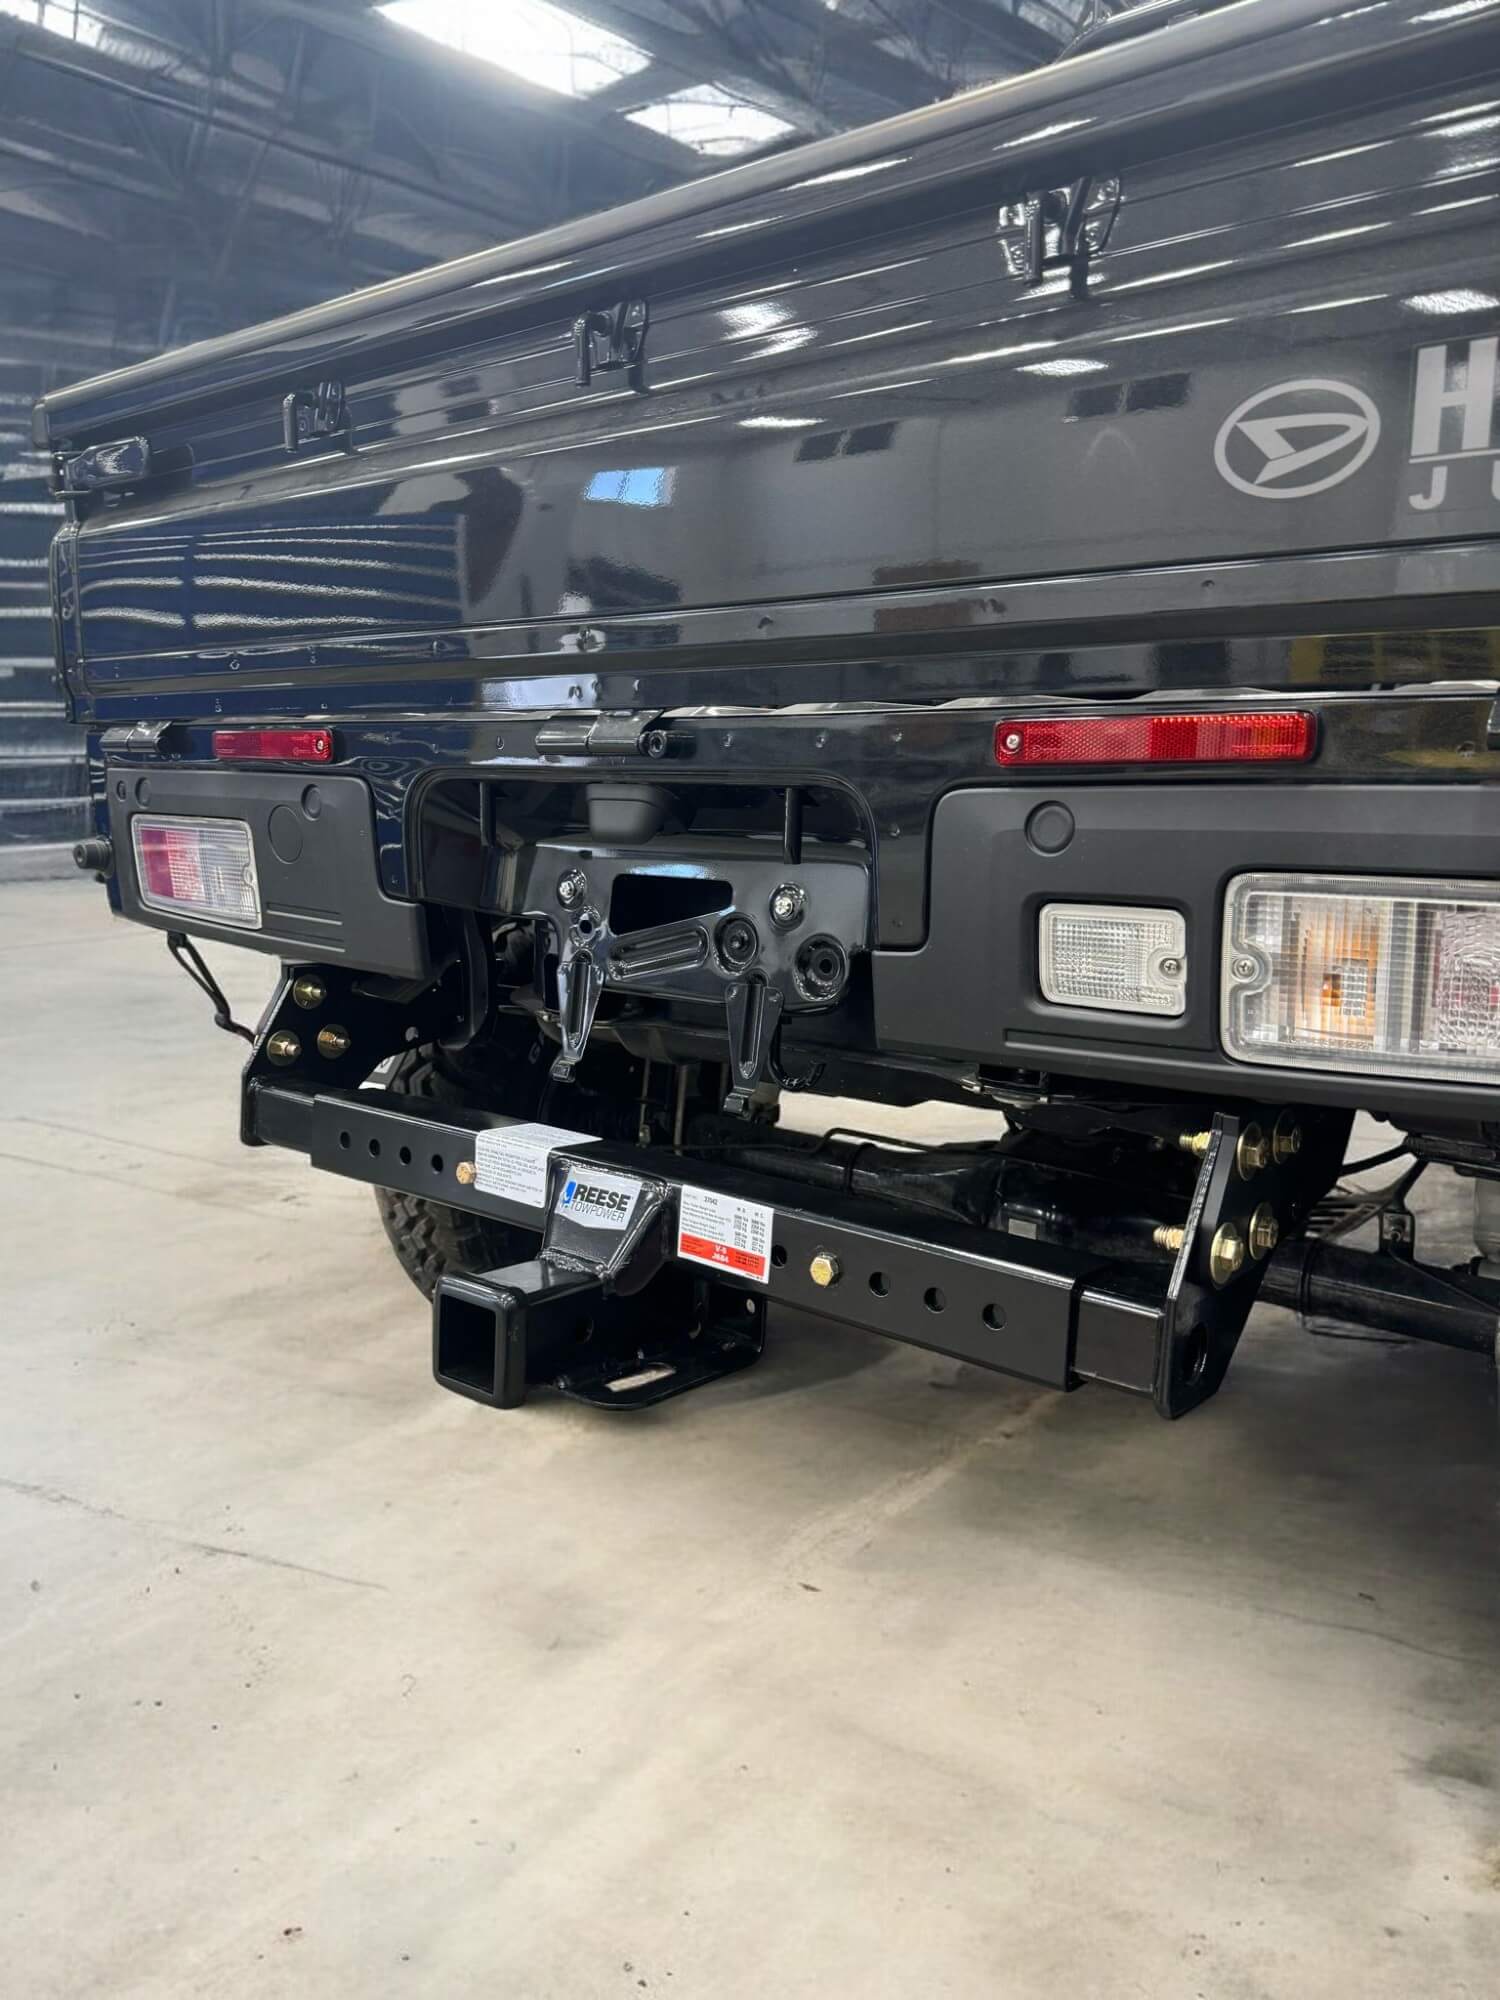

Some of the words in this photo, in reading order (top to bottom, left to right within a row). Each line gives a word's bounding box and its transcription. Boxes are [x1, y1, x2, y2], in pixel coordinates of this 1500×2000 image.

[1408, 459, 1500, 510] J
[570, 1200, 626, 1223] TOWPOWER
[573, 1183, 631, 1213] REESE
